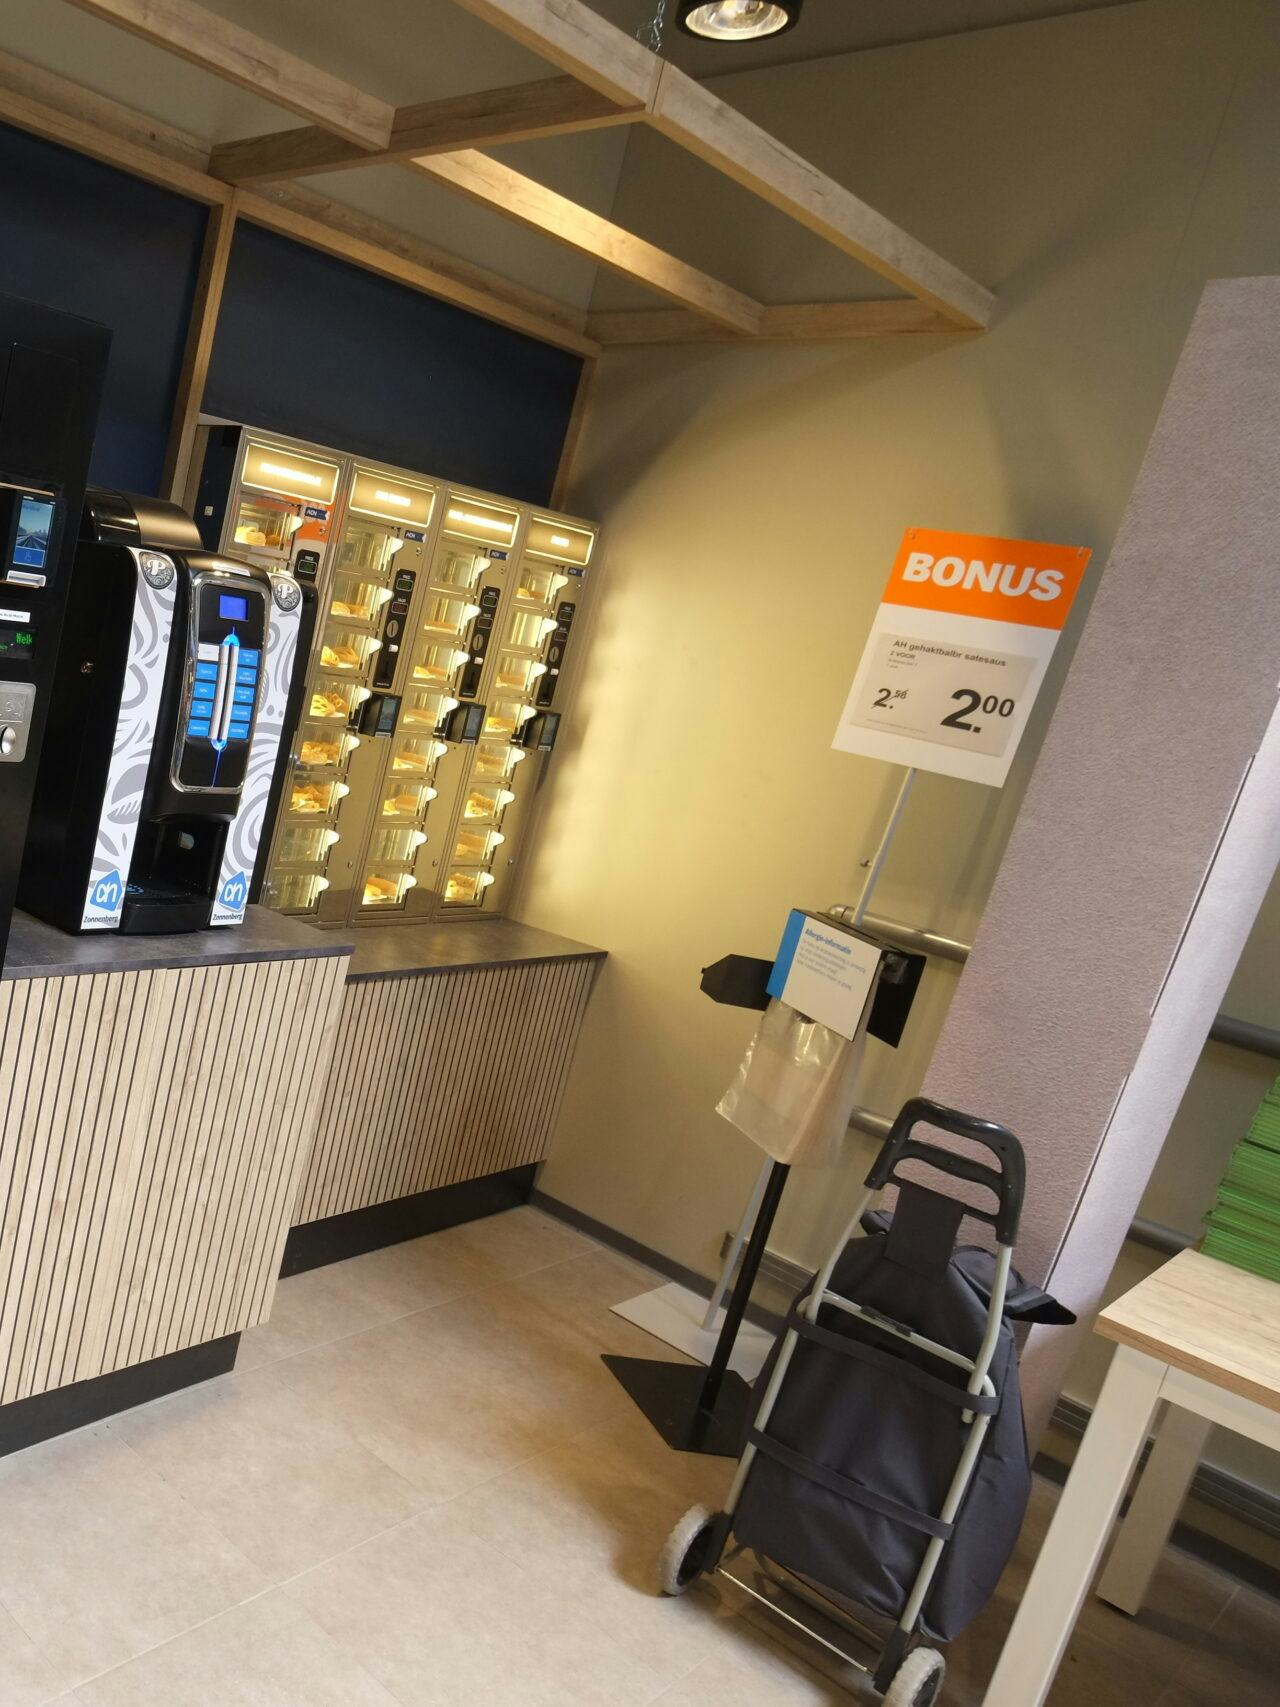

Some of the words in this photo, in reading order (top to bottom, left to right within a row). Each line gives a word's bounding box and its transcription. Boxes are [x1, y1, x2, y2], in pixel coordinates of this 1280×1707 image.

[902, 552, 1064, 601] BONUS
[893, 640, 907, 648] AH
[964, 653, 1007, 667] satesaus
[895, 651, 916, 659] VOOR
[83, 915, 118, 924] Zonnenberg
[212, 912, 242, 921] Zonnenberg
